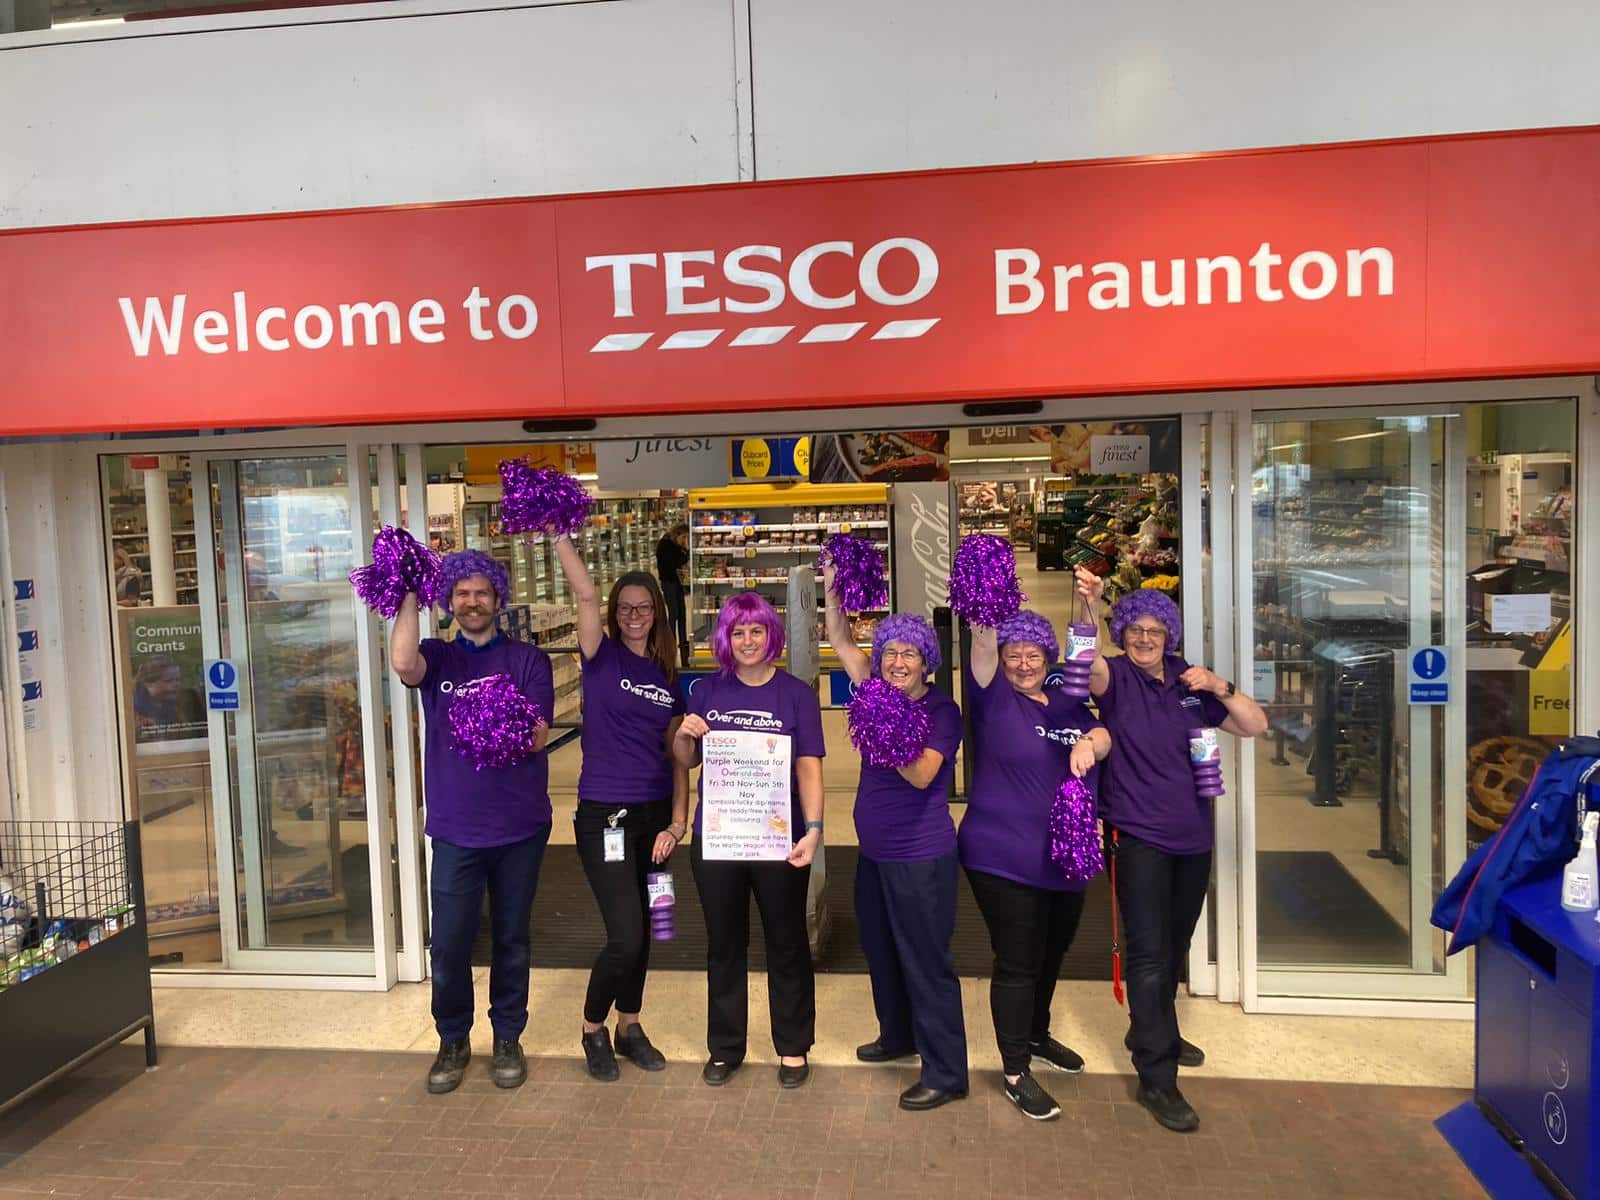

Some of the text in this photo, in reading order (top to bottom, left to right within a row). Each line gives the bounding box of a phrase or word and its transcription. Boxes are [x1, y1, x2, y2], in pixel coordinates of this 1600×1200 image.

[585, 237, 939, 318] TESCO
[994, 242, 1394, 316] Braunton
[118, 286, 539, 358] Welcome to
[136, 625, 200, 638] Commun
[136, 641, 186, 654] Grants
[620, 679, 644, 696] Over
[706, 709, 783, 728] Over and above
[706, 737, 737, 745] TESCO
[705, 758, 784, 766] Purple Weekend for
[721, 768, 740, 777] Over
[737, 780, 770, 788] Nov-Sun
